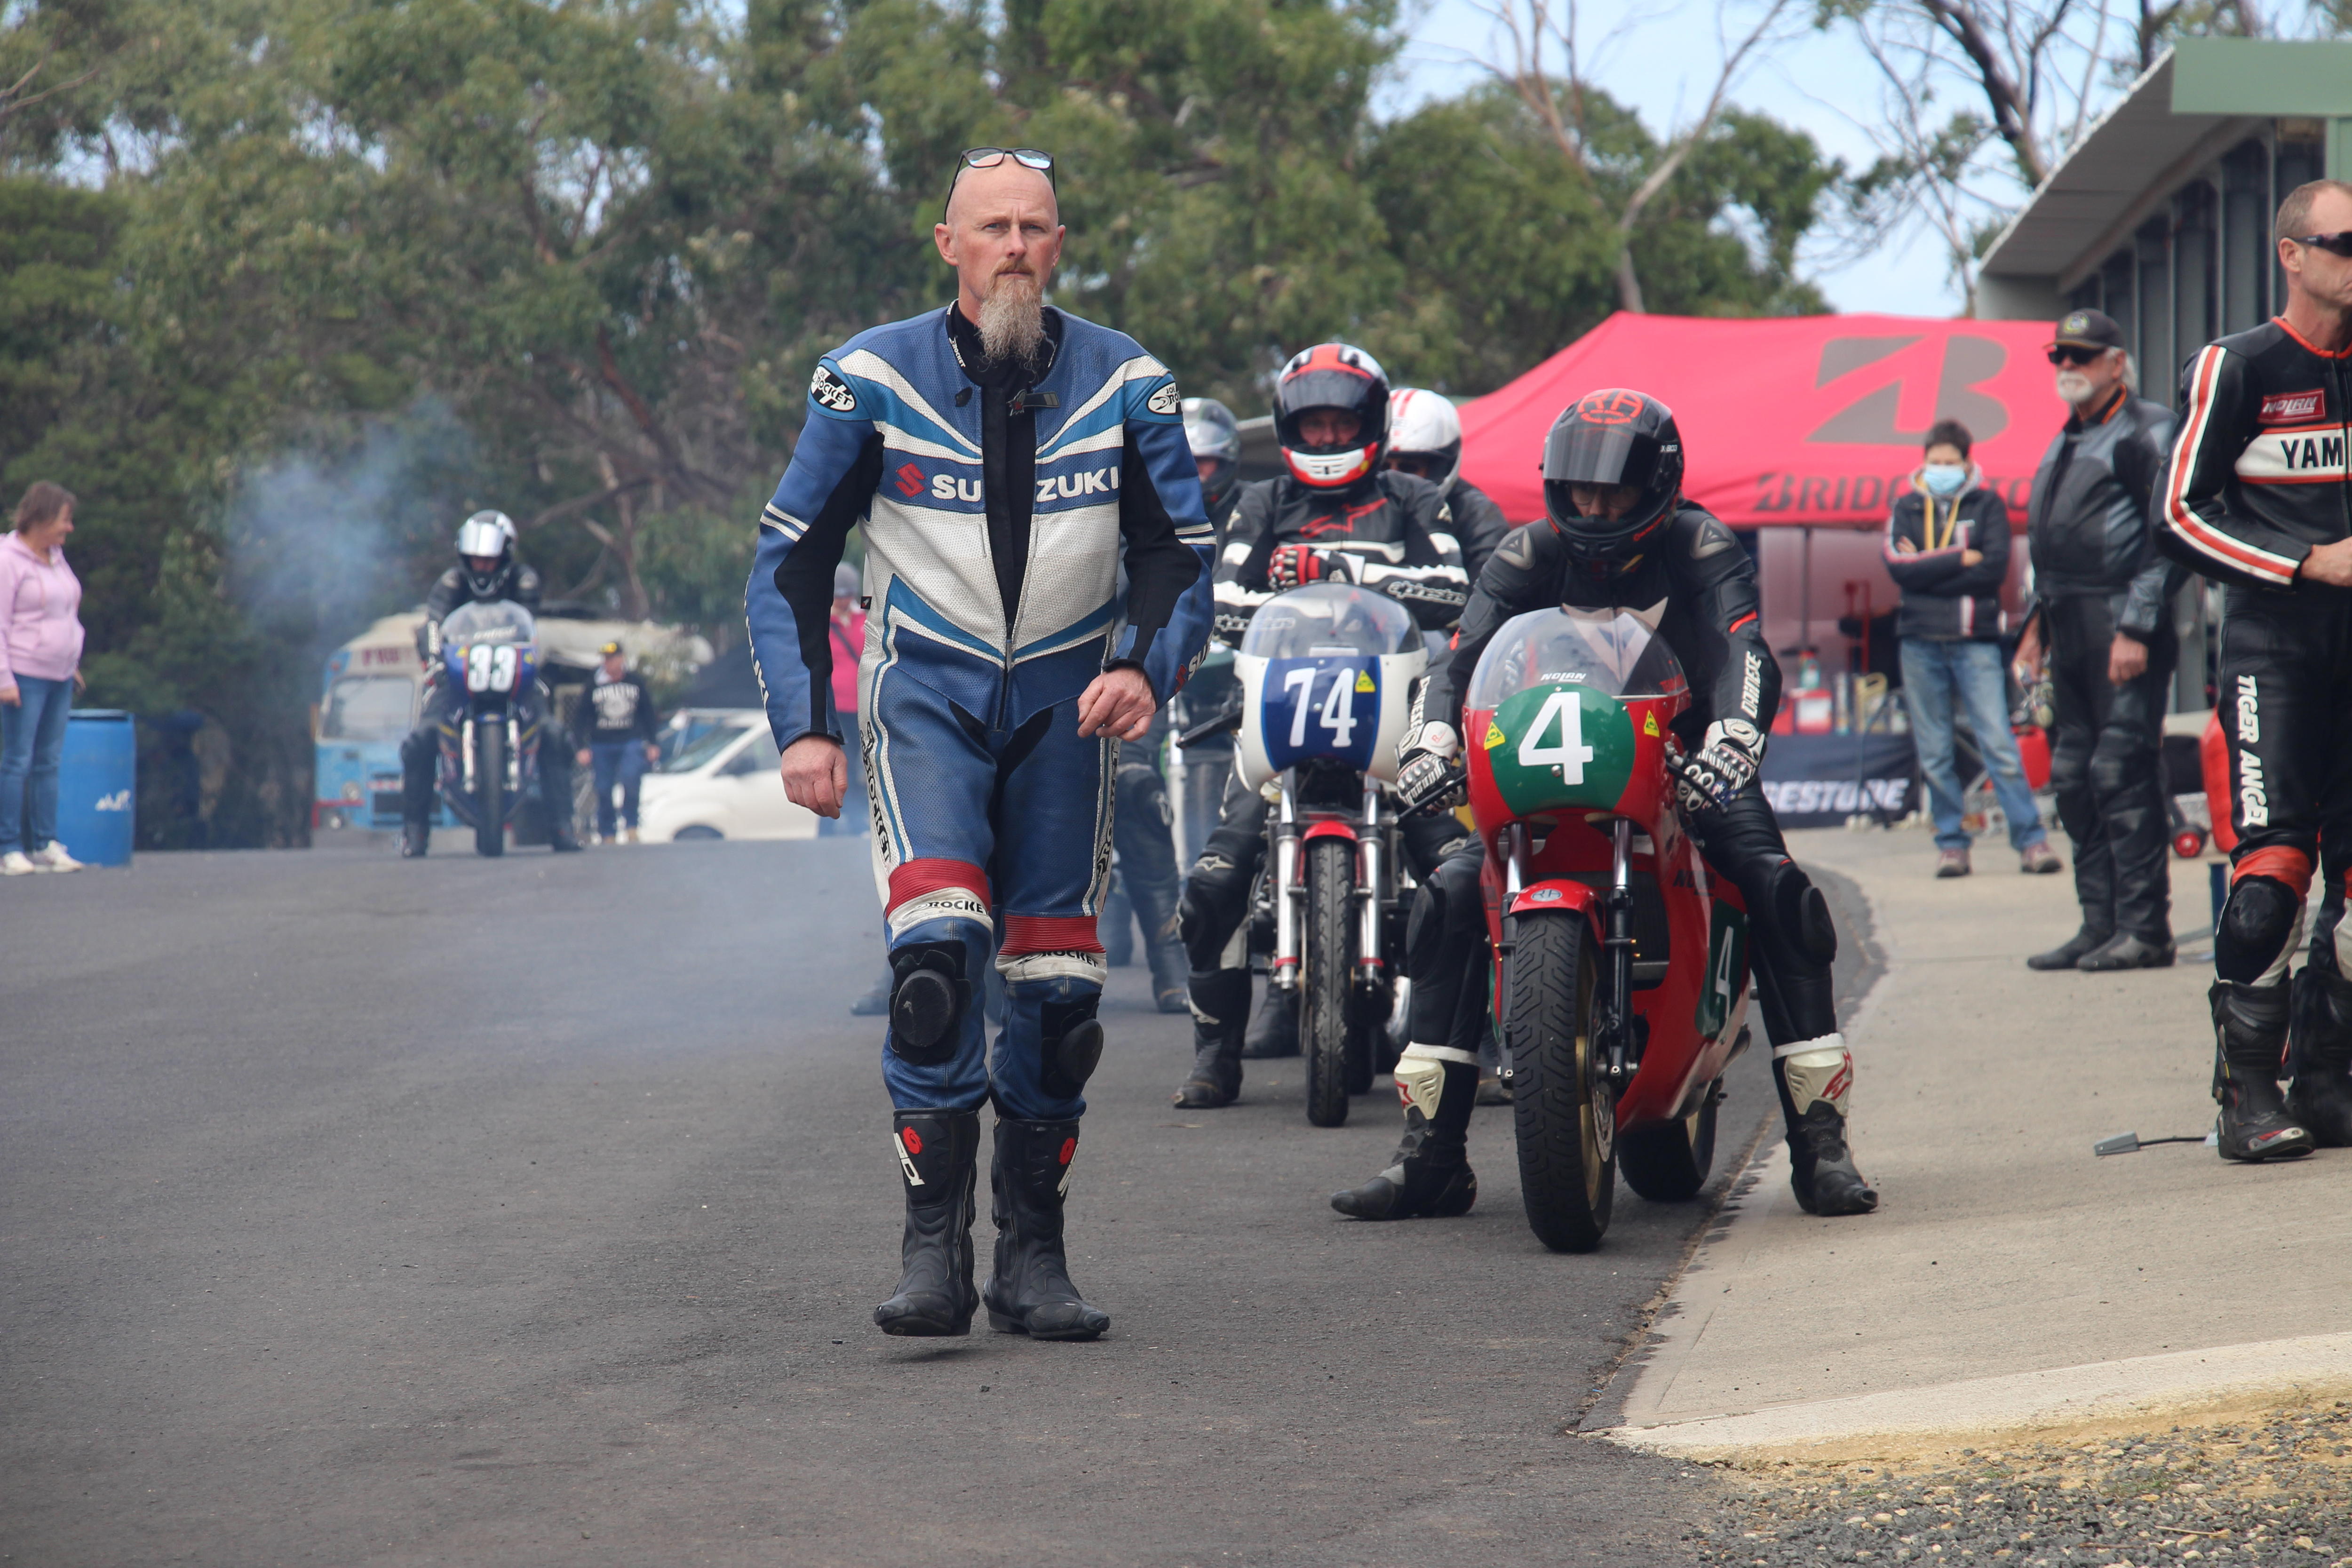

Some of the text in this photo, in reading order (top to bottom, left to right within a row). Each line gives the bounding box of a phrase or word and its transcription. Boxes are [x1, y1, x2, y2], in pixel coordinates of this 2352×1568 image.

[950, 340, 966, 368] ROCKET
[813, 375, 853, 406] ROCKET
[1166, 386, 1176, 394] JOE
[2263, 396, 2319, 415] NOLAN
[2280, 436, 2344, 469] YAM
[468, 644, 517, 692] 33
[1540, 671, 1587, 683] NOLAN
[1284, 667, 1358, 748] 74
[1518, 692, 1593, 785] 4
[2236, 674, 2269, 827] TIGER ANGEL
[921, 900, 988, 915] ROCKE
[1037, 950, 1099, 968] ROCKET
